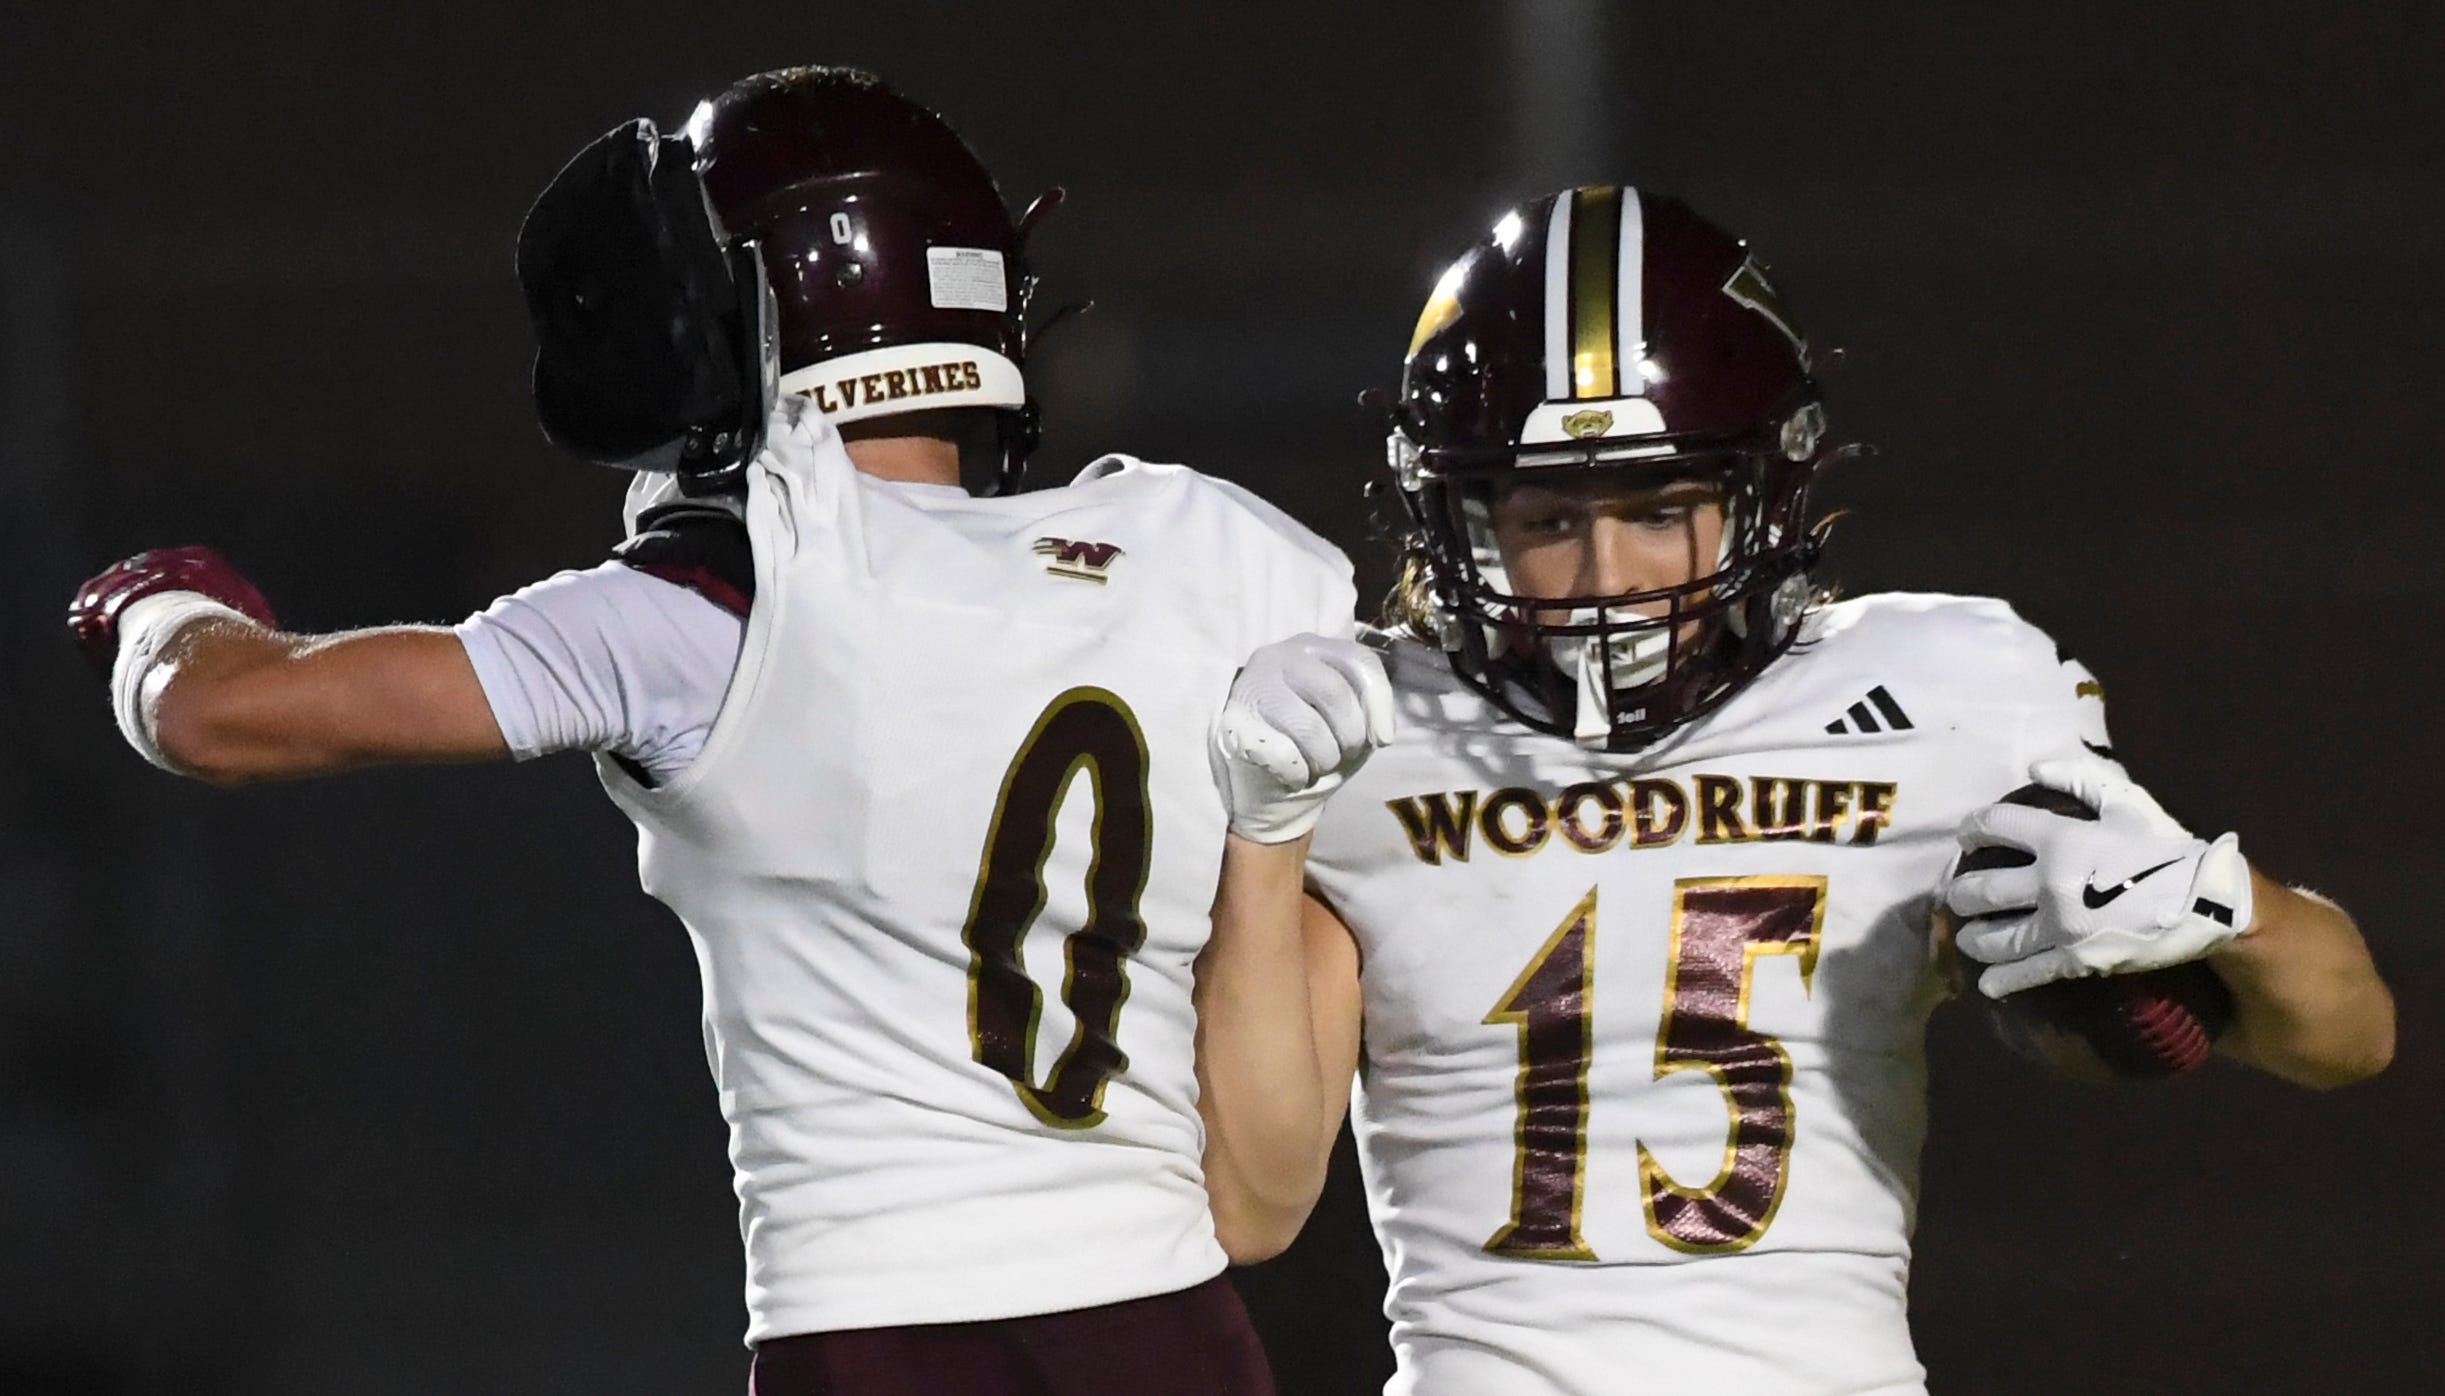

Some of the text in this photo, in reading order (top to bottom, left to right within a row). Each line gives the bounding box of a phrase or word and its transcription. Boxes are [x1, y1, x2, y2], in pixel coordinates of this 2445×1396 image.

[795, 361, 982, 415] LVERINES
[961, 685, 1154, 1130] 0
[1386, 774, 1897, 866] WOODRUFF
[1482, 875, 1829, 1260] 15
